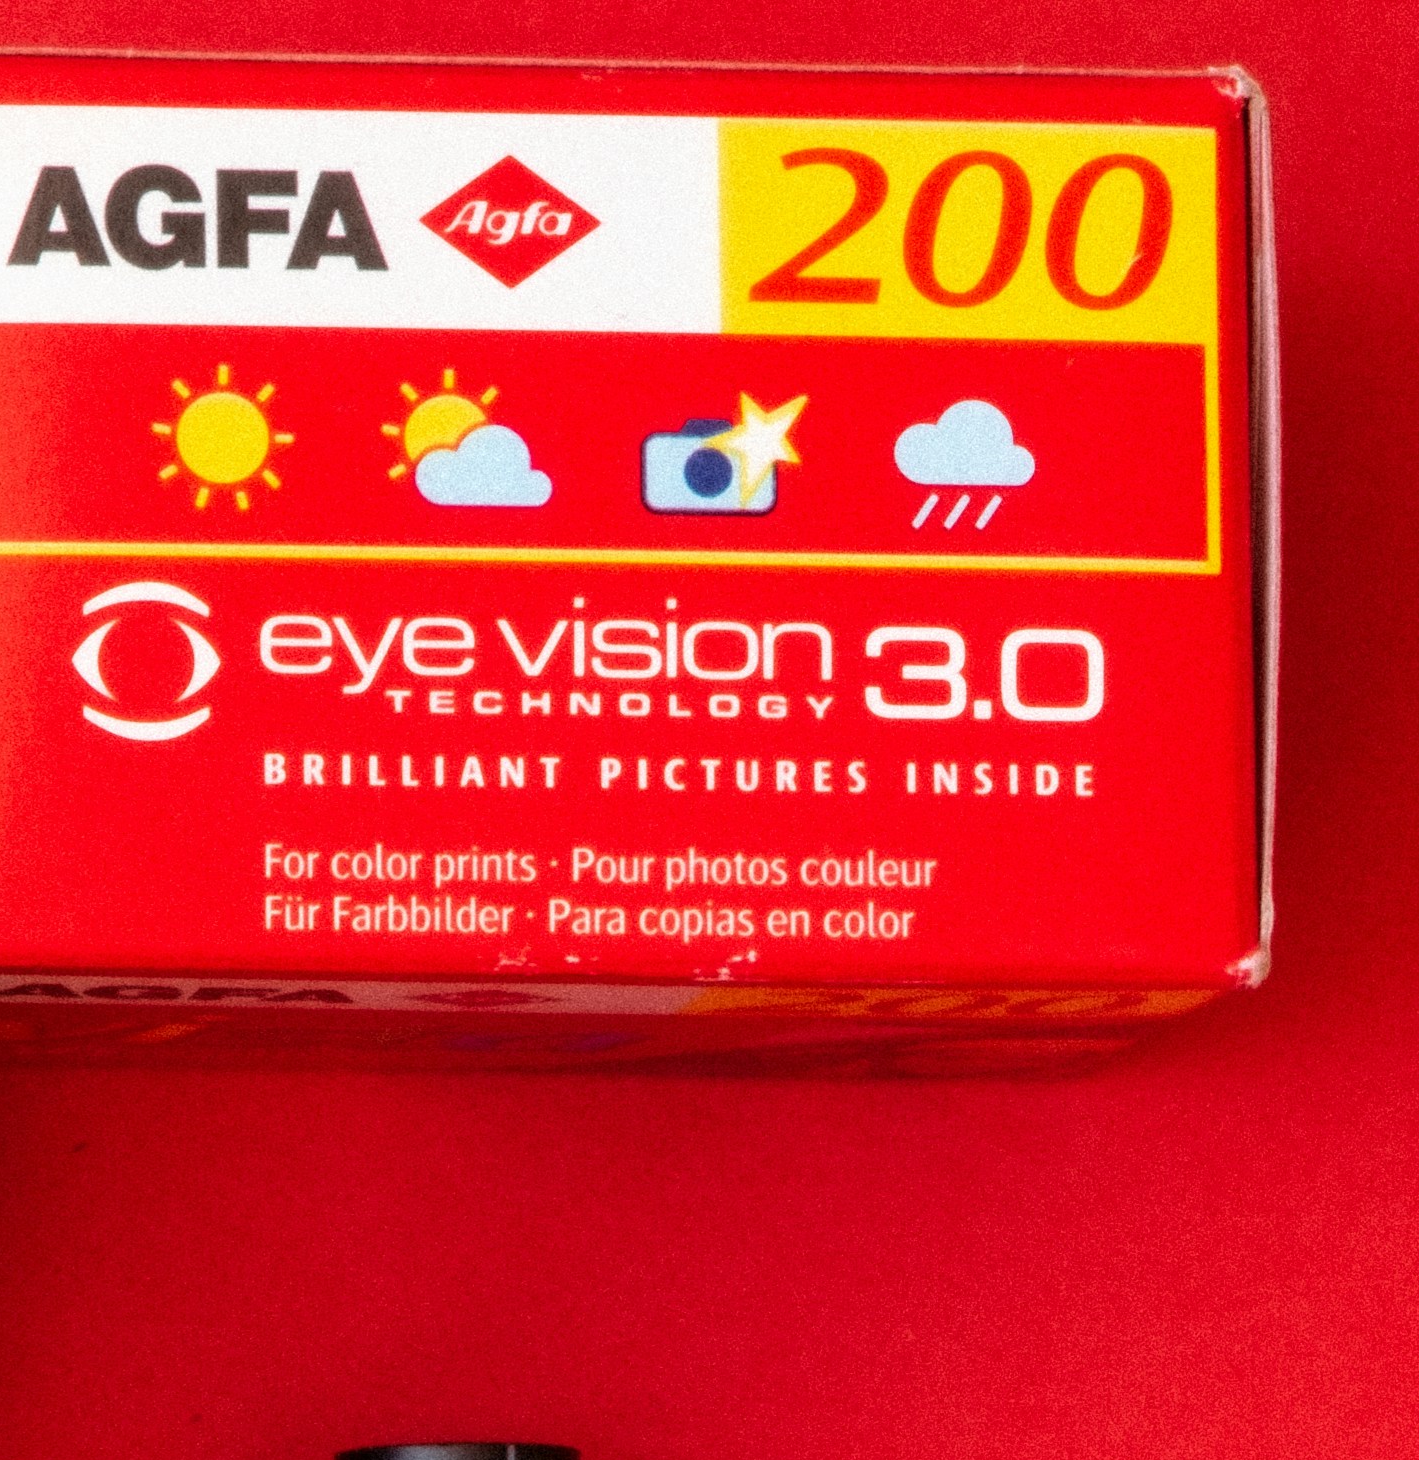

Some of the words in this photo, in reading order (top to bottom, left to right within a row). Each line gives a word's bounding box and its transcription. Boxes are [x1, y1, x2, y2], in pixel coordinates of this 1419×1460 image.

[9, 164, 389, 272] AGFA
[445, 199, 573, 245] Agfa
[748, 147, 1174, 311] 200
[259, 613, 476, 694] eye
[497, 596, 834, 681] vision
[865, 626, 1105, 723] 3.0
[385, 690, 834, 720] TECHNOLOGY
[262, 751, 562, 789] BRILLIANT
[600, 756, 867, 794] PICTURES
[906, 762, 1094, 797] INSIDE
[263, 842, 320, 880] For
[330, 842, 423, 881] color
[434, 847, 537, 889] prints
[571, 846, 655, 885] Pour
[665, 847, 789, 892] photos
[799, 849, 938, 888] couleur
[263, 894, 321, 931] Für
[332, 894, 515, 934] Farbbilder
[548, 898, 626, 936] Para
[638, 903, 755, 944] copias
[766, 908, 811, 938] en
[823, 901, 916, 940] color
